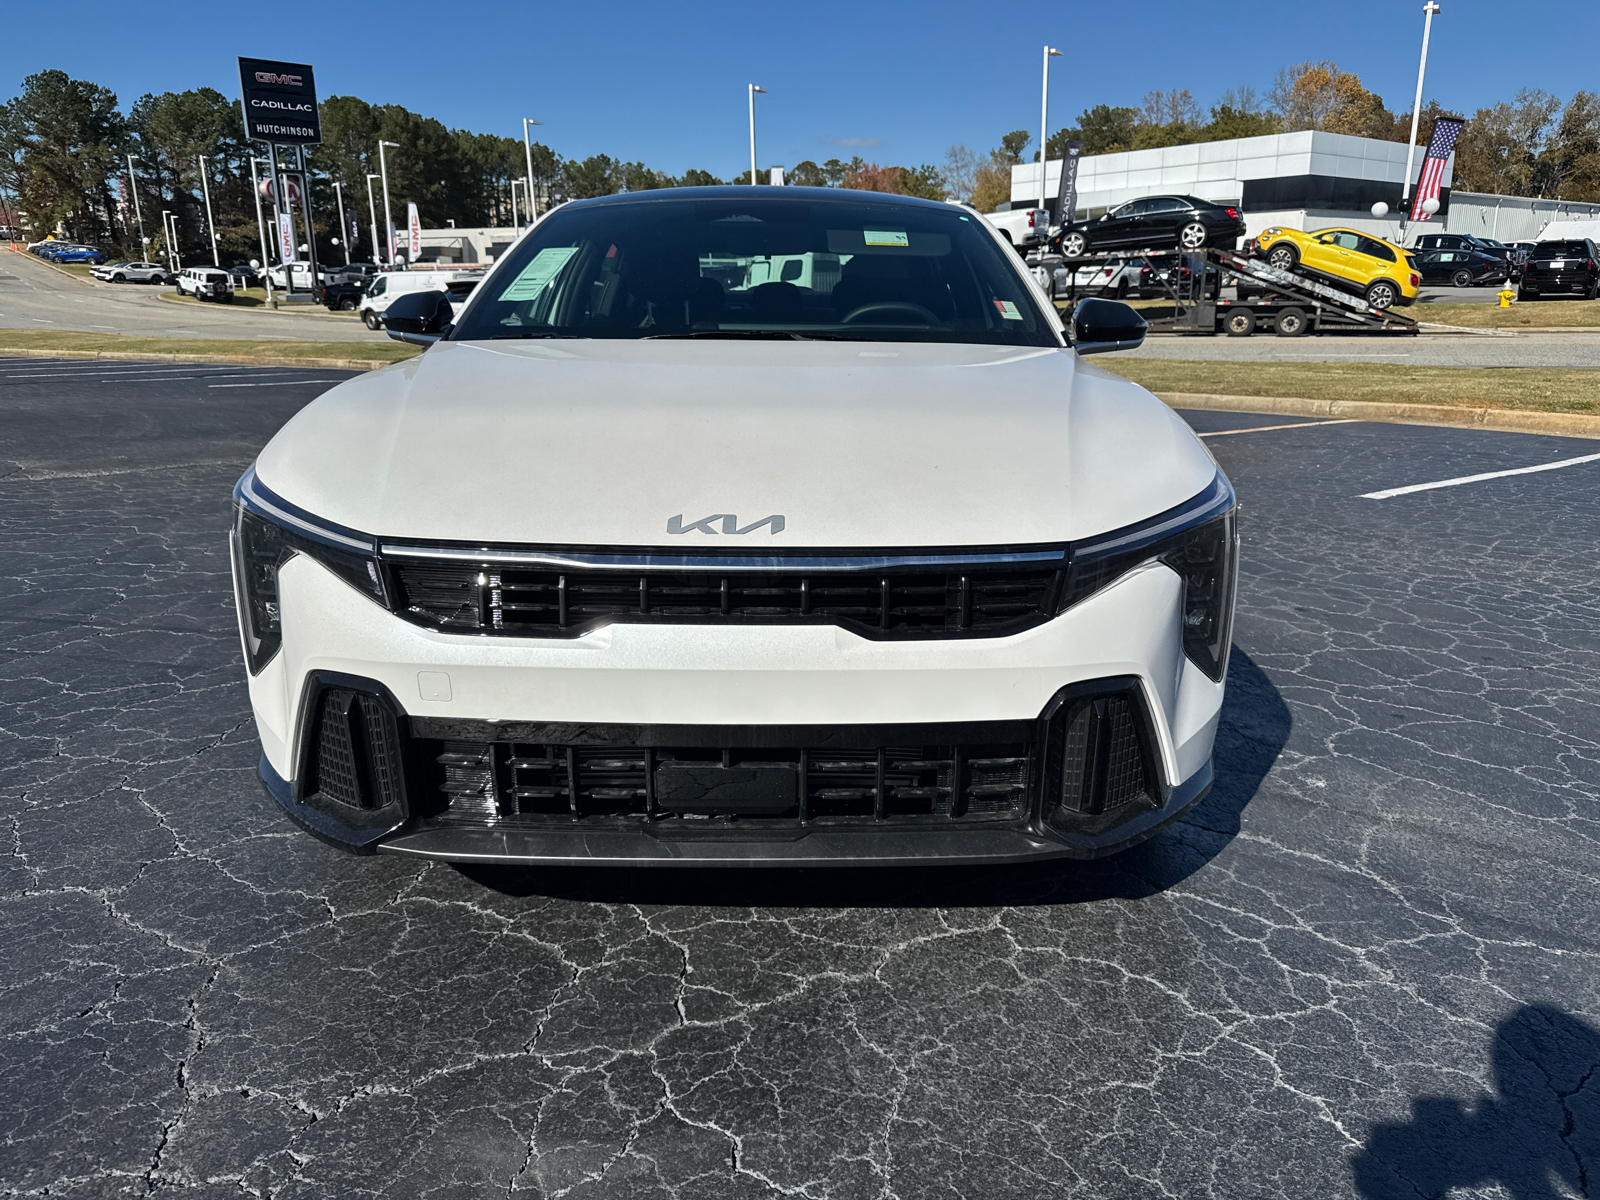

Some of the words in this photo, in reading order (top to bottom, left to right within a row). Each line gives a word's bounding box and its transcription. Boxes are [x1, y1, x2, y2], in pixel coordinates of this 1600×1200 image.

[255, 71, 303, 87] GMC
[251, 99, 313, 112] CADILLAC
[256, 124, 314, 137] HUTCHINSON
[1062, 159, 1076, 221] CADILLAC
[282, 223, 291, 258] GMC
[411, 215, 420, 253] GMC
[666, 513, 786, 535] KIA
